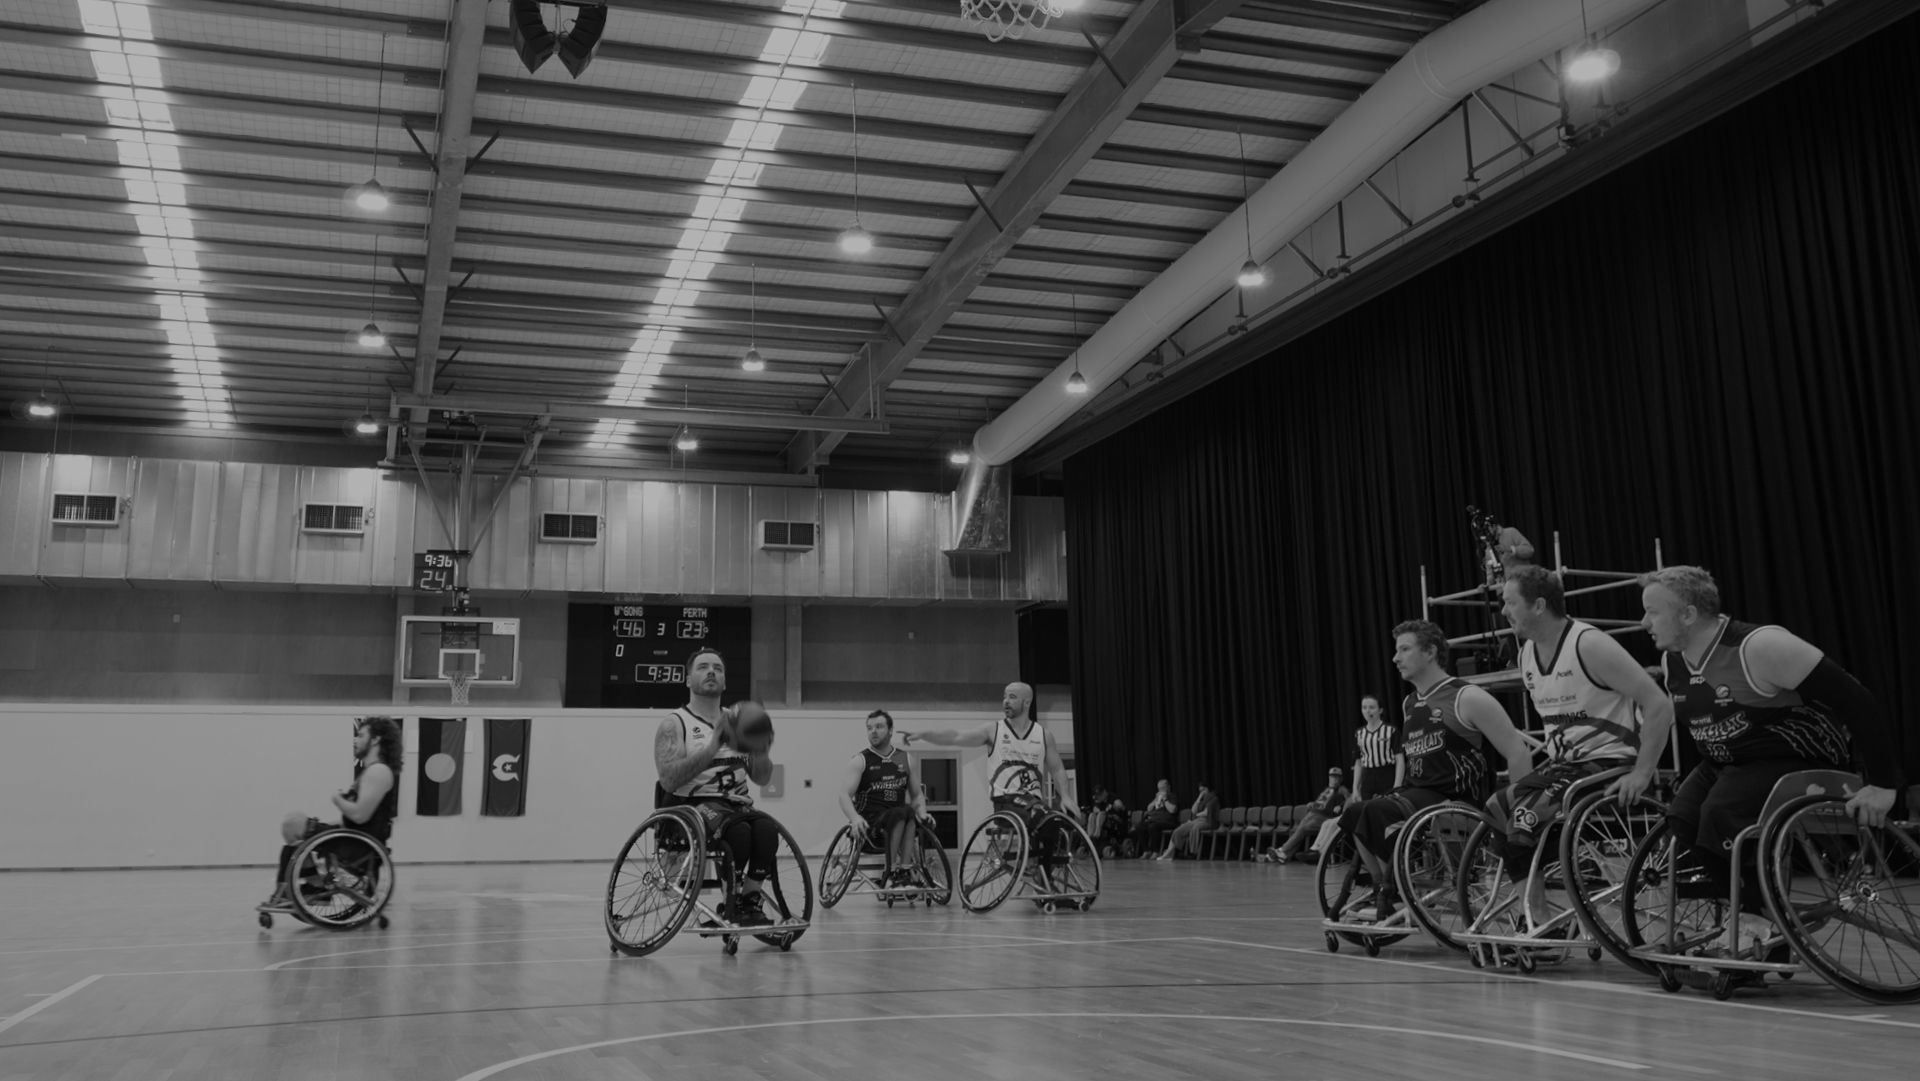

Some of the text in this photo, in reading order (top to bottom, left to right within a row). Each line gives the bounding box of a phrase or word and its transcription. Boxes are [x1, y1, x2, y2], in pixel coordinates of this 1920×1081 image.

[425, 555, 452, 567] 9:36
[420, 570, 446, 588] 24
[682, 607, 707, 618] PERTH
[623, 621, 642, 637] 46
[657, 622, 665, 636] 3
[682, 622, 702, 638] 23
[615, 644, 624, 657] 0
[648, 666, 681, 682] 9:36
